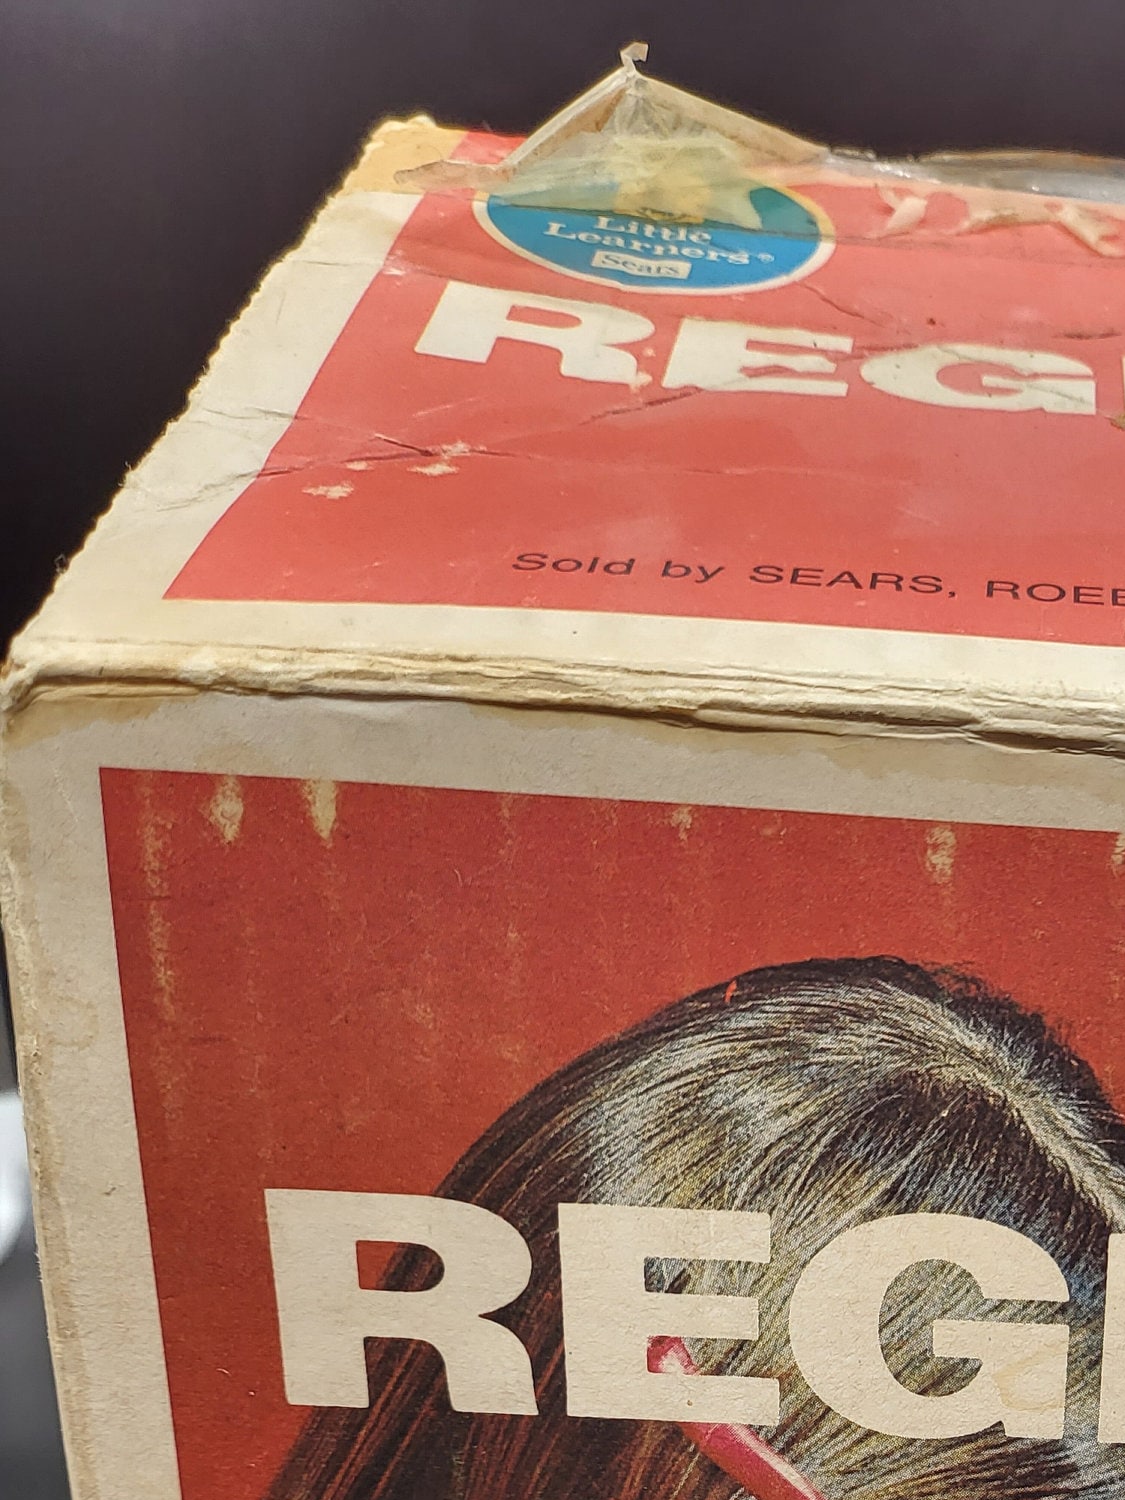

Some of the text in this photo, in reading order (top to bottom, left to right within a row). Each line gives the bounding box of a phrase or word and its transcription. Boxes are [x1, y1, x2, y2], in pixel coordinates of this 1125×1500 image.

[597, 215, 712, 245] Little
[600, 253, 681, 278] Sears
[511, 552, 636, 577] Sold
[661, 559, 726, 585] by
[748, 565, 957, 600] SEARS,
